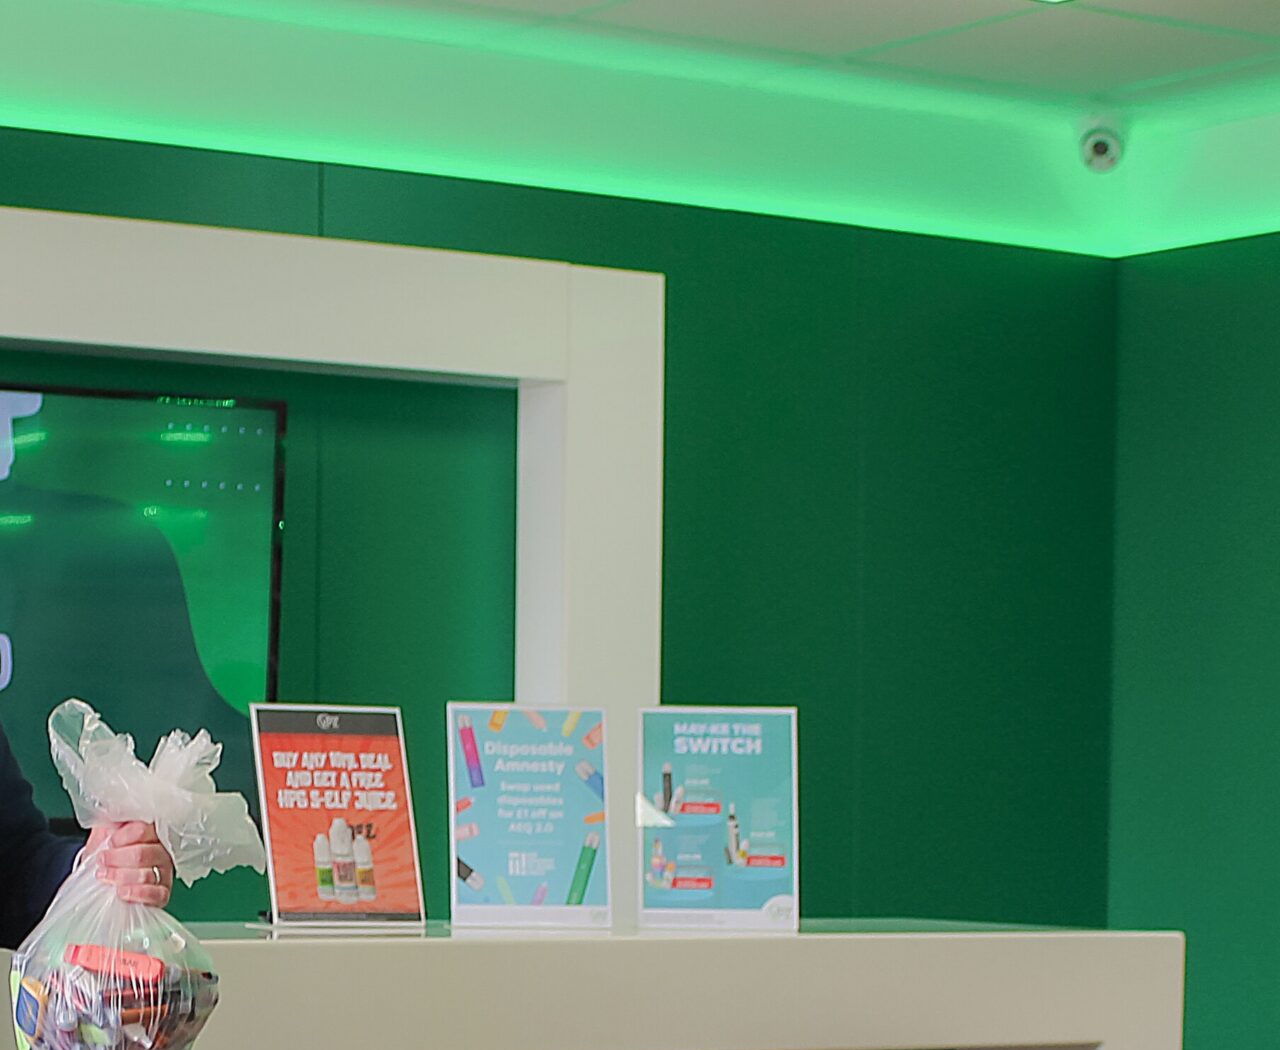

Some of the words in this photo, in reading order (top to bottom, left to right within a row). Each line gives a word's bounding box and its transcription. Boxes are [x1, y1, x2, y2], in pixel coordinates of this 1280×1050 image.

[484, 741, 574, 757] Disposable
[674, 736, 762, 755] SWITCH
[272, 751, 299, 769] BUY
[301, 752, 327, 770] ANY
[493, 758, 565, 776] Amnesty
[286, 770, 312, 789] AND
[313, 770, 337, 788] GET
[340, 771, 351, 790] A
[353, 790, 398, 811] JUICE
